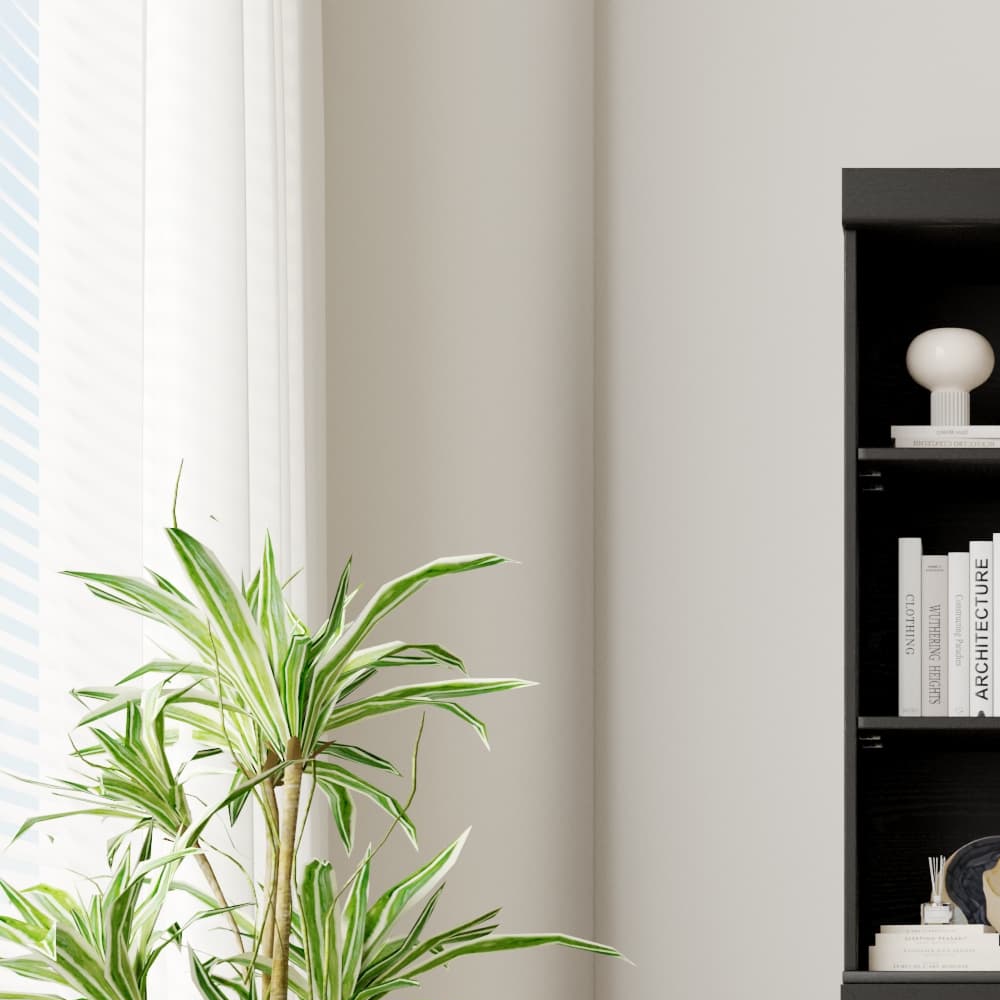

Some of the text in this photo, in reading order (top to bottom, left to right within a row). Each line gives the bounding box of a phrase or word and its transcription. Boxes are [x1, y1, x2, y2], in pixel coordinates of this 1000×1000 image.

[904, 594, 914, 656] CLOTHING
[928, 604, 941, 704] WUTHERING HEIGHTS
[975, 558, 988, 700] ARCHITECTURE
